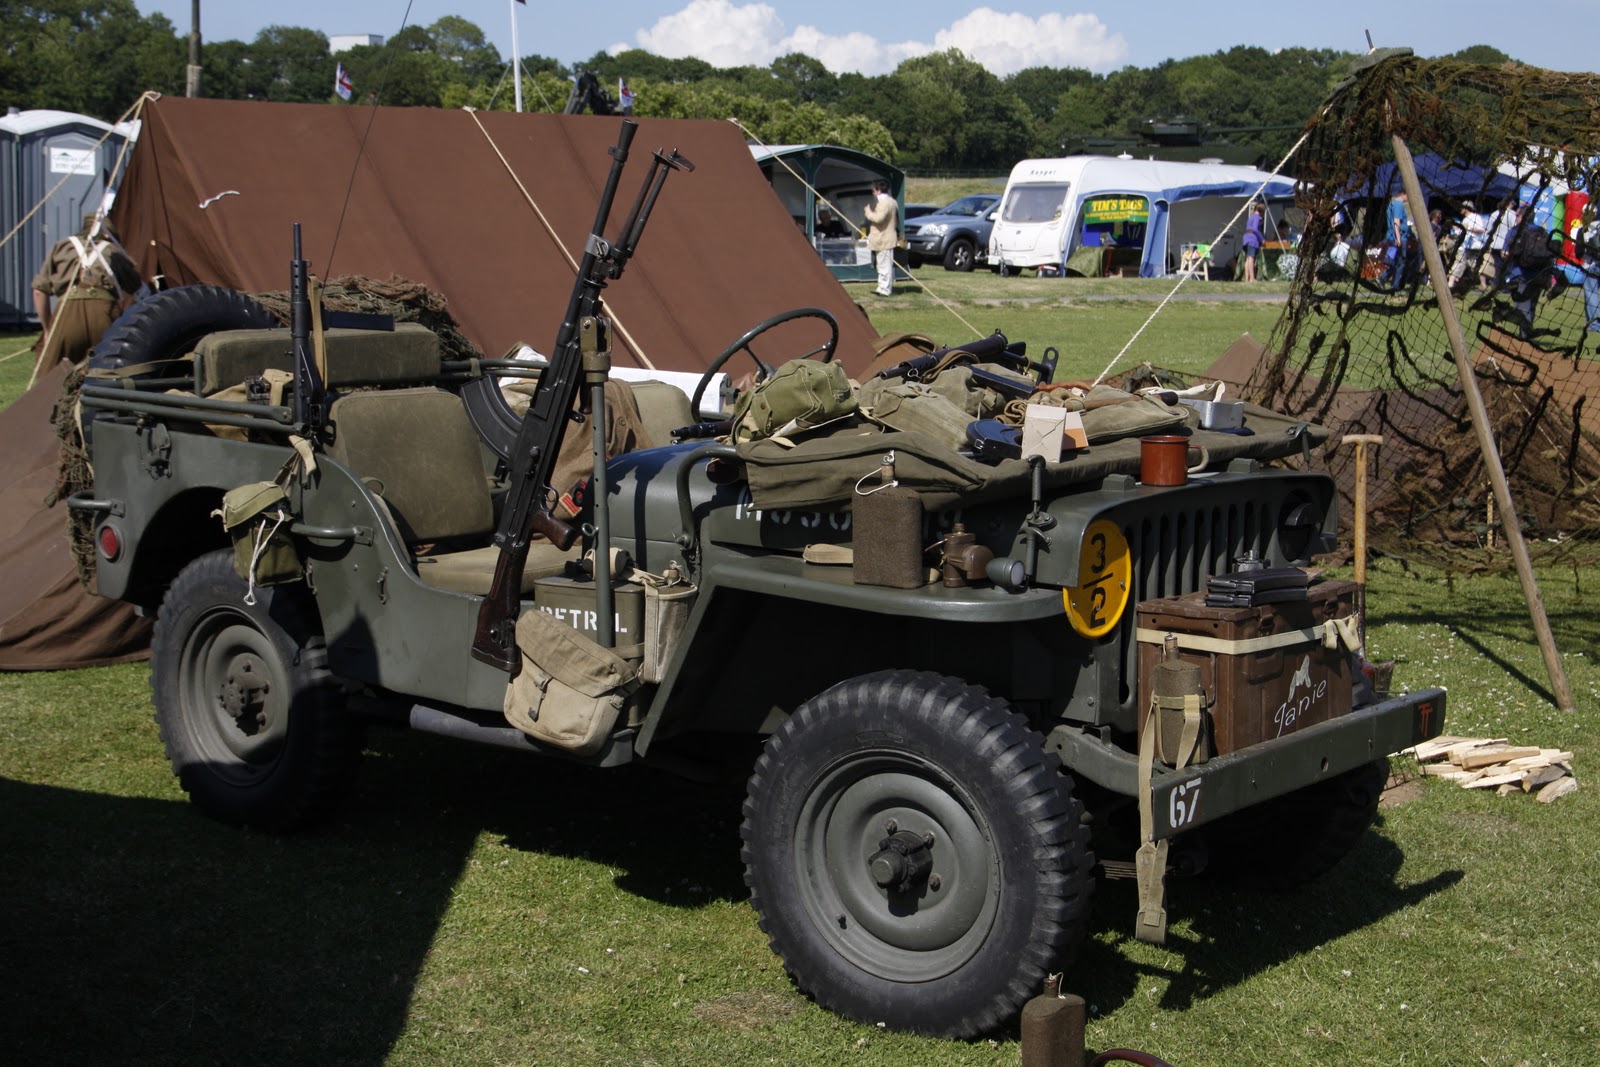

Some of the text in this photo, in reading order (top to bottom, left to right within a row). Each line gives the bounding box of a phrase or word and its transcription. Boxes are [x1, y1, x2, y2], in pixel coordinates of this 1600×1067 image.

[1092, 199, 1143, 212] TIM'S TAGS
[1170, 777, 1202, 829] 67
